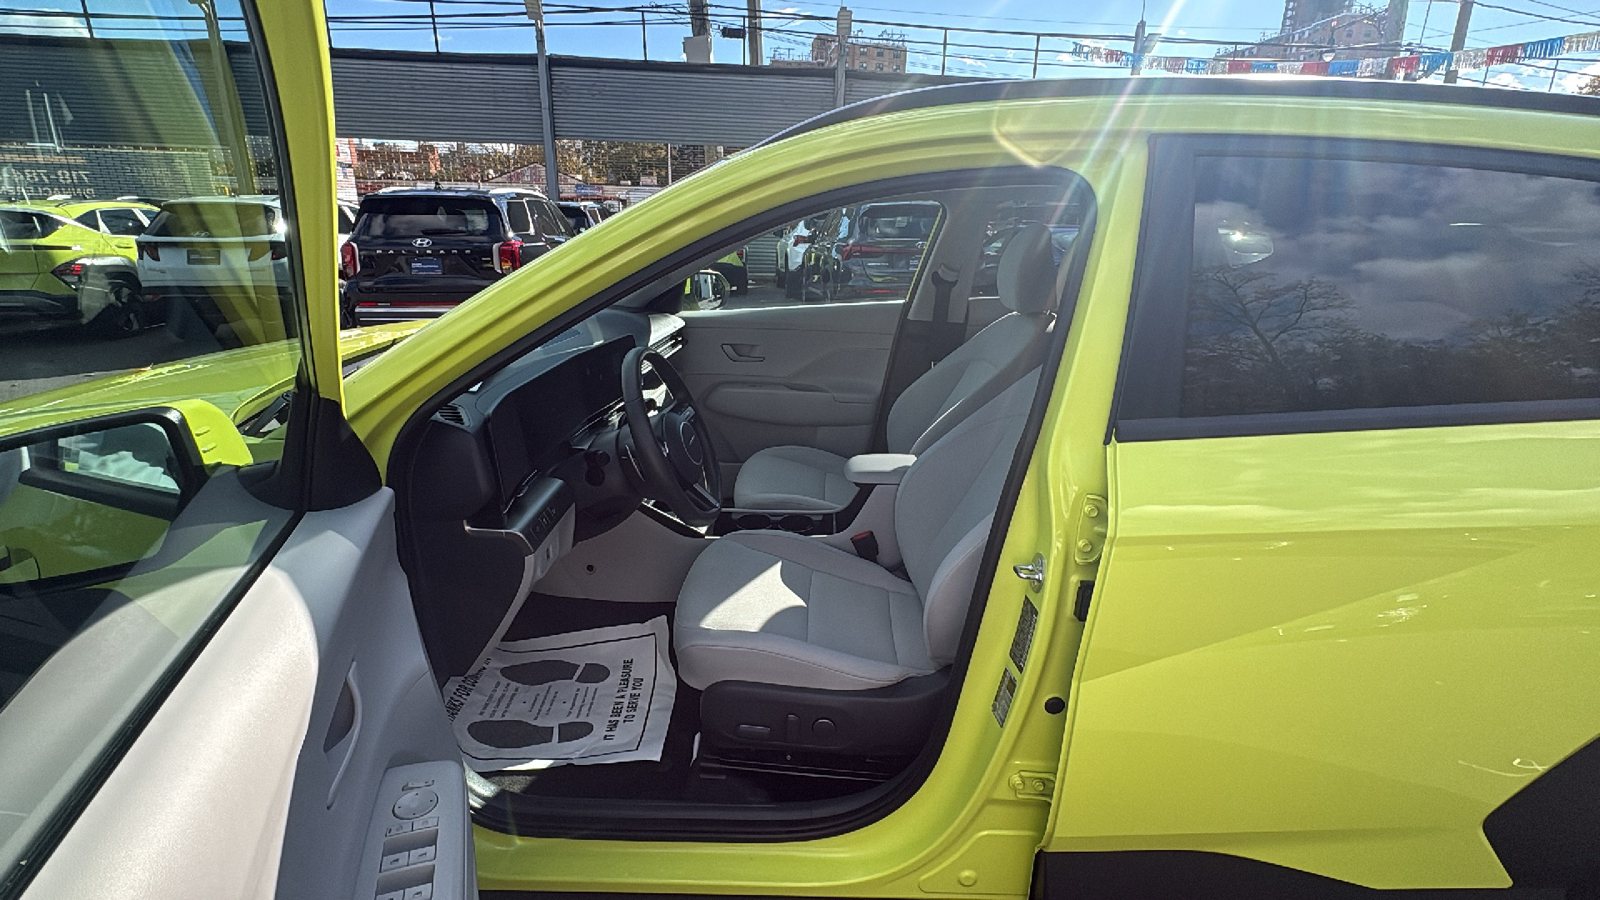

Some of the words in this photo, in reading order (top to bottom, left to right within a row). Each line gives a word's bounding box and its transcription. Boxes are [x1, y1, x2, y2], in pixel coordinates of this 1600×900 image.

[616, 658, 633, 693] PLEASURE
[631, 677, 644, 691] YOU
[453, 684, 474, 701] FOR
[610, 701, 624, 718] BEEN
[626, 692, 641, 713] SERVE
[605, 719, 620, 732] HAS
[623, 714, 636, 724] TO
